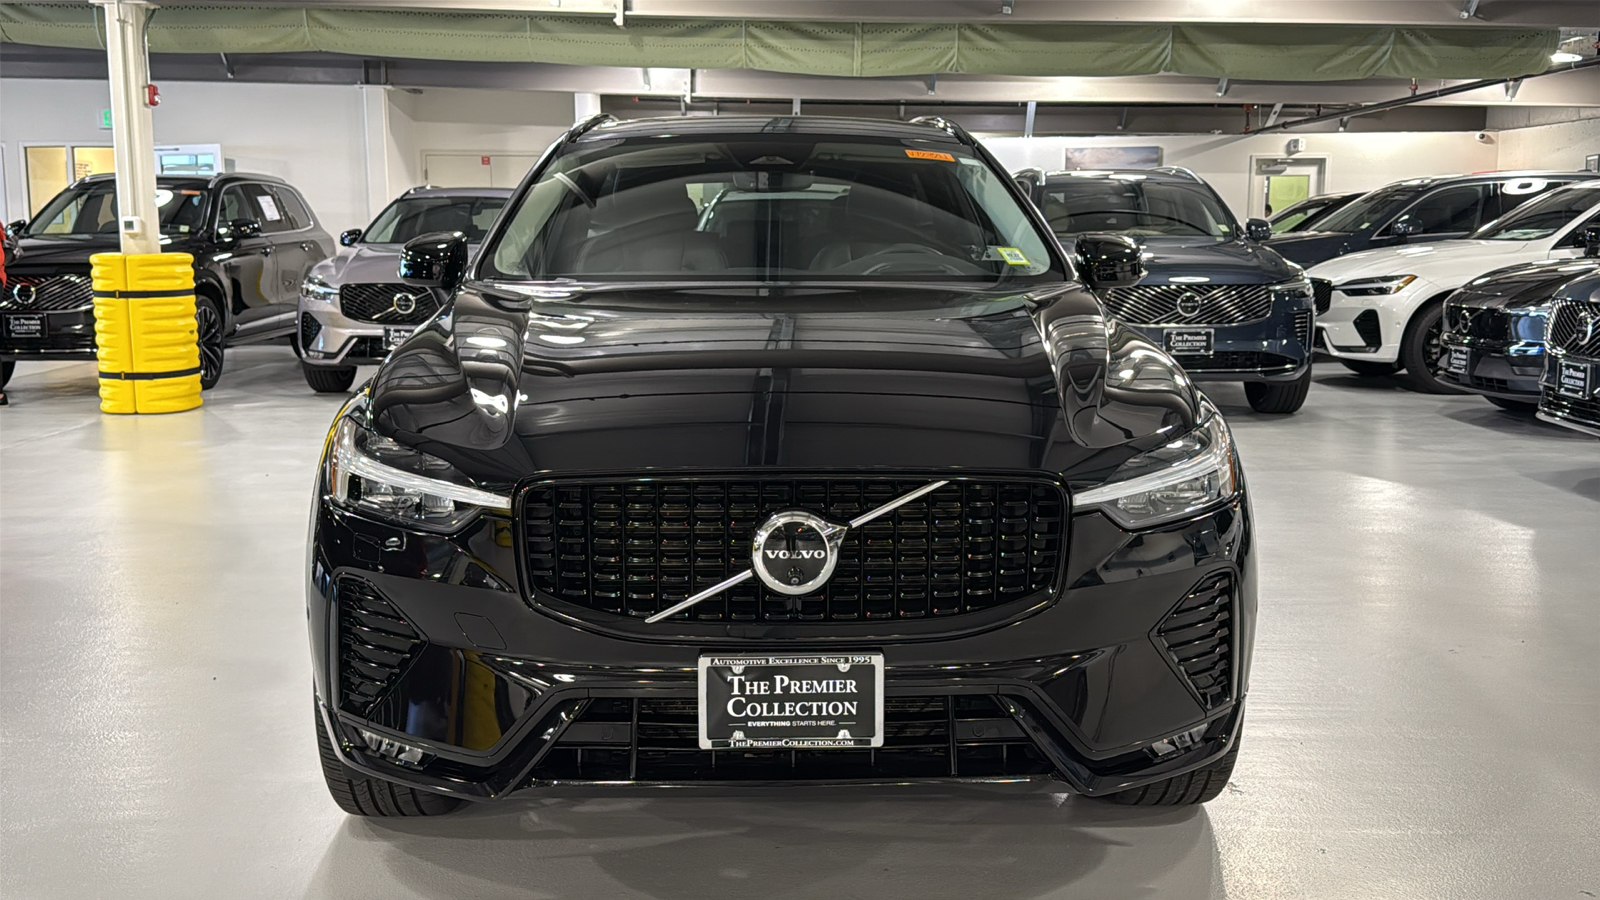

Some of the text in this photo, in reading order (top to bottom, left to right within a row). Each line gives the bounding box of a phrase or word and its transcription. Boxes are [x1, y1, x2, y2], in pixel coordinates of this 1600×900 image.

[765, 549, 825, 559] VOLVO
[712, 655, 871, 666] AUTOMOTIVE EXCELLENCE SINCE 1995
[727, 675, 857, 695] THE PREMIER
[727, 696, 857, 717] COLLECTION
